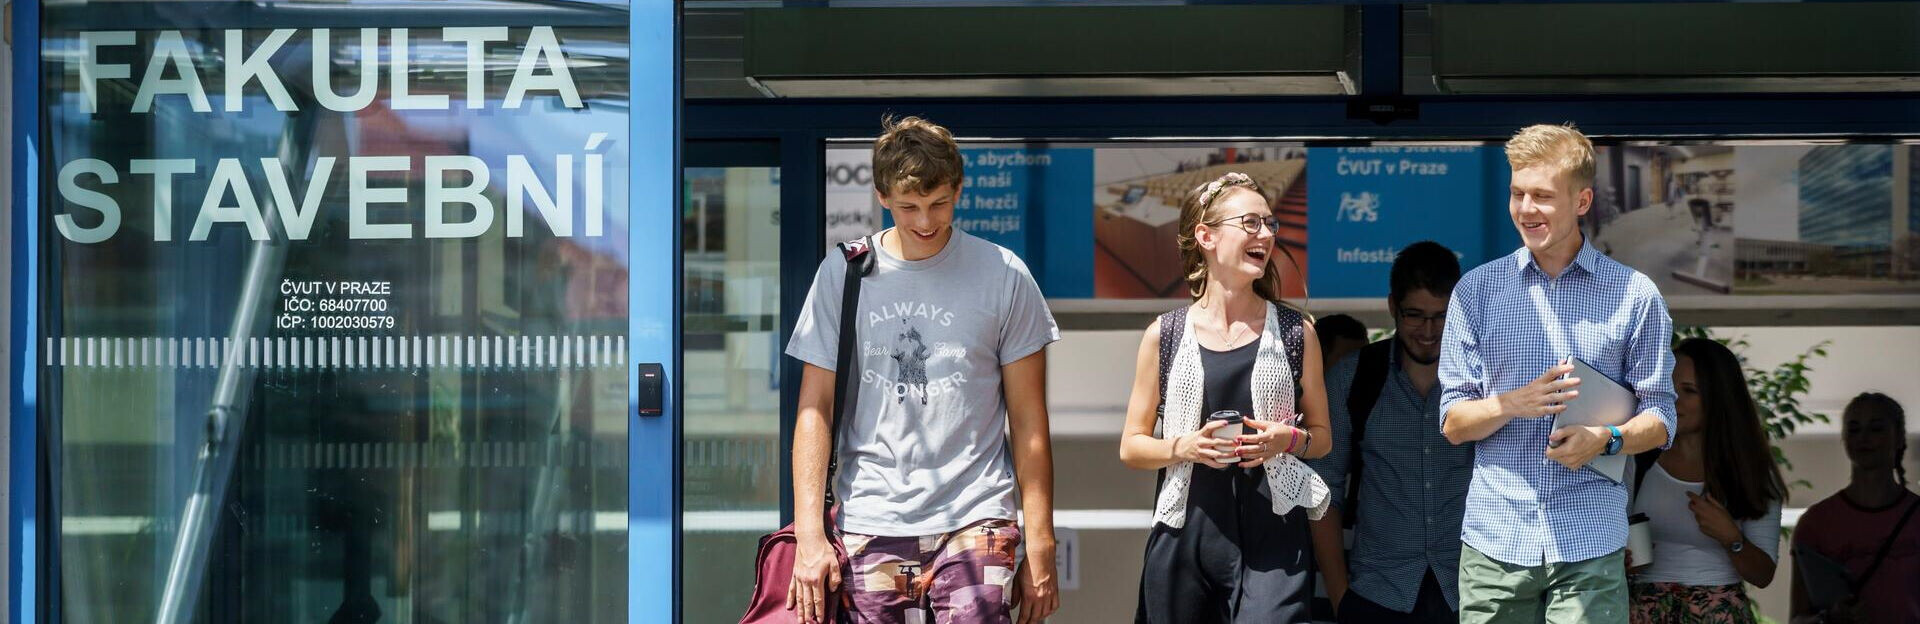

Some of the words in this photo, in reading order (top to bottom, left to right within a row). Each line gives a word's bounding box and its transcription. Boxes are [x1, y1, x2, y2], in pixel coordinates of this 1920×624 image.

[77, 25, 584, 114] FAKULTA
[976, 151, 1052, 169] abychom
[1336, 156, 1382, 176] ČVUT
[1385, 162, 1397, 176] v
[1399, 159, 1449, 176] Praze
[53, 132, 609, 244] STAVEBNÍ
[280, 278, 323, 295] ČVUT
[325, 281, 337, 295] V
[340, 281, 391, 295] PRAZE
[284, 295, 315, 312] IČO:
[319, 298, 387, 312] 68407700
[276, 313, 306, 329] IČP:
[310, 315, 395, 329] 1002030579
[868, 301, 955, 328] ALWAYS
[863, 340, 890, 358] Bear
[934, 341, 967, 363] Camp
[861, 368, 968, 398] STRONGER
